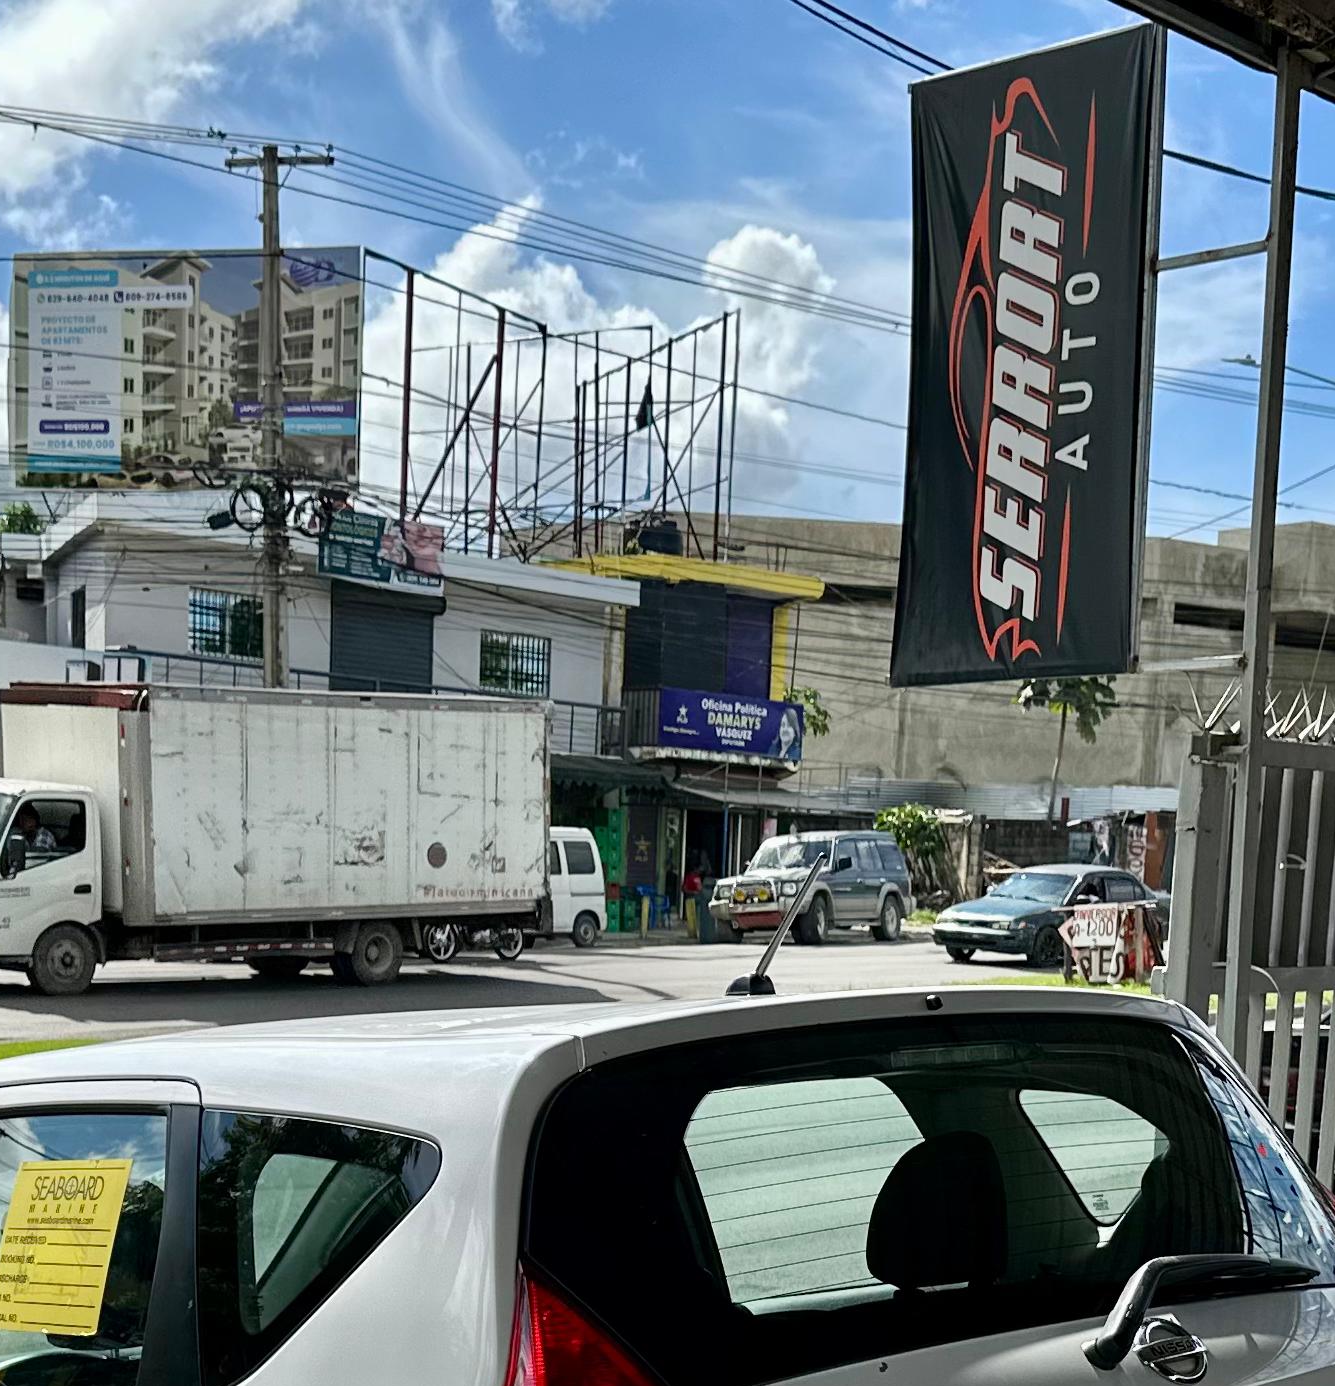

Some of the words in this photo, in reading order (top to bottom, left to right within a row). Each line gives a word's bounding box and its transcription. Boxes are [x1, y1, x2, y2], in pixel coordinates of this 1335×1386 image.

[980, 130, 1067, 622] SERRORT
[1053, 270, 1101, 472] AUTO
[701, 698, 733, 713] Oficina
[707, 712, 762, 731] DAMARYS
[30, 1175, 105, 1201] SEABOARD
[28, 1203, 99, 1214] MARINE
